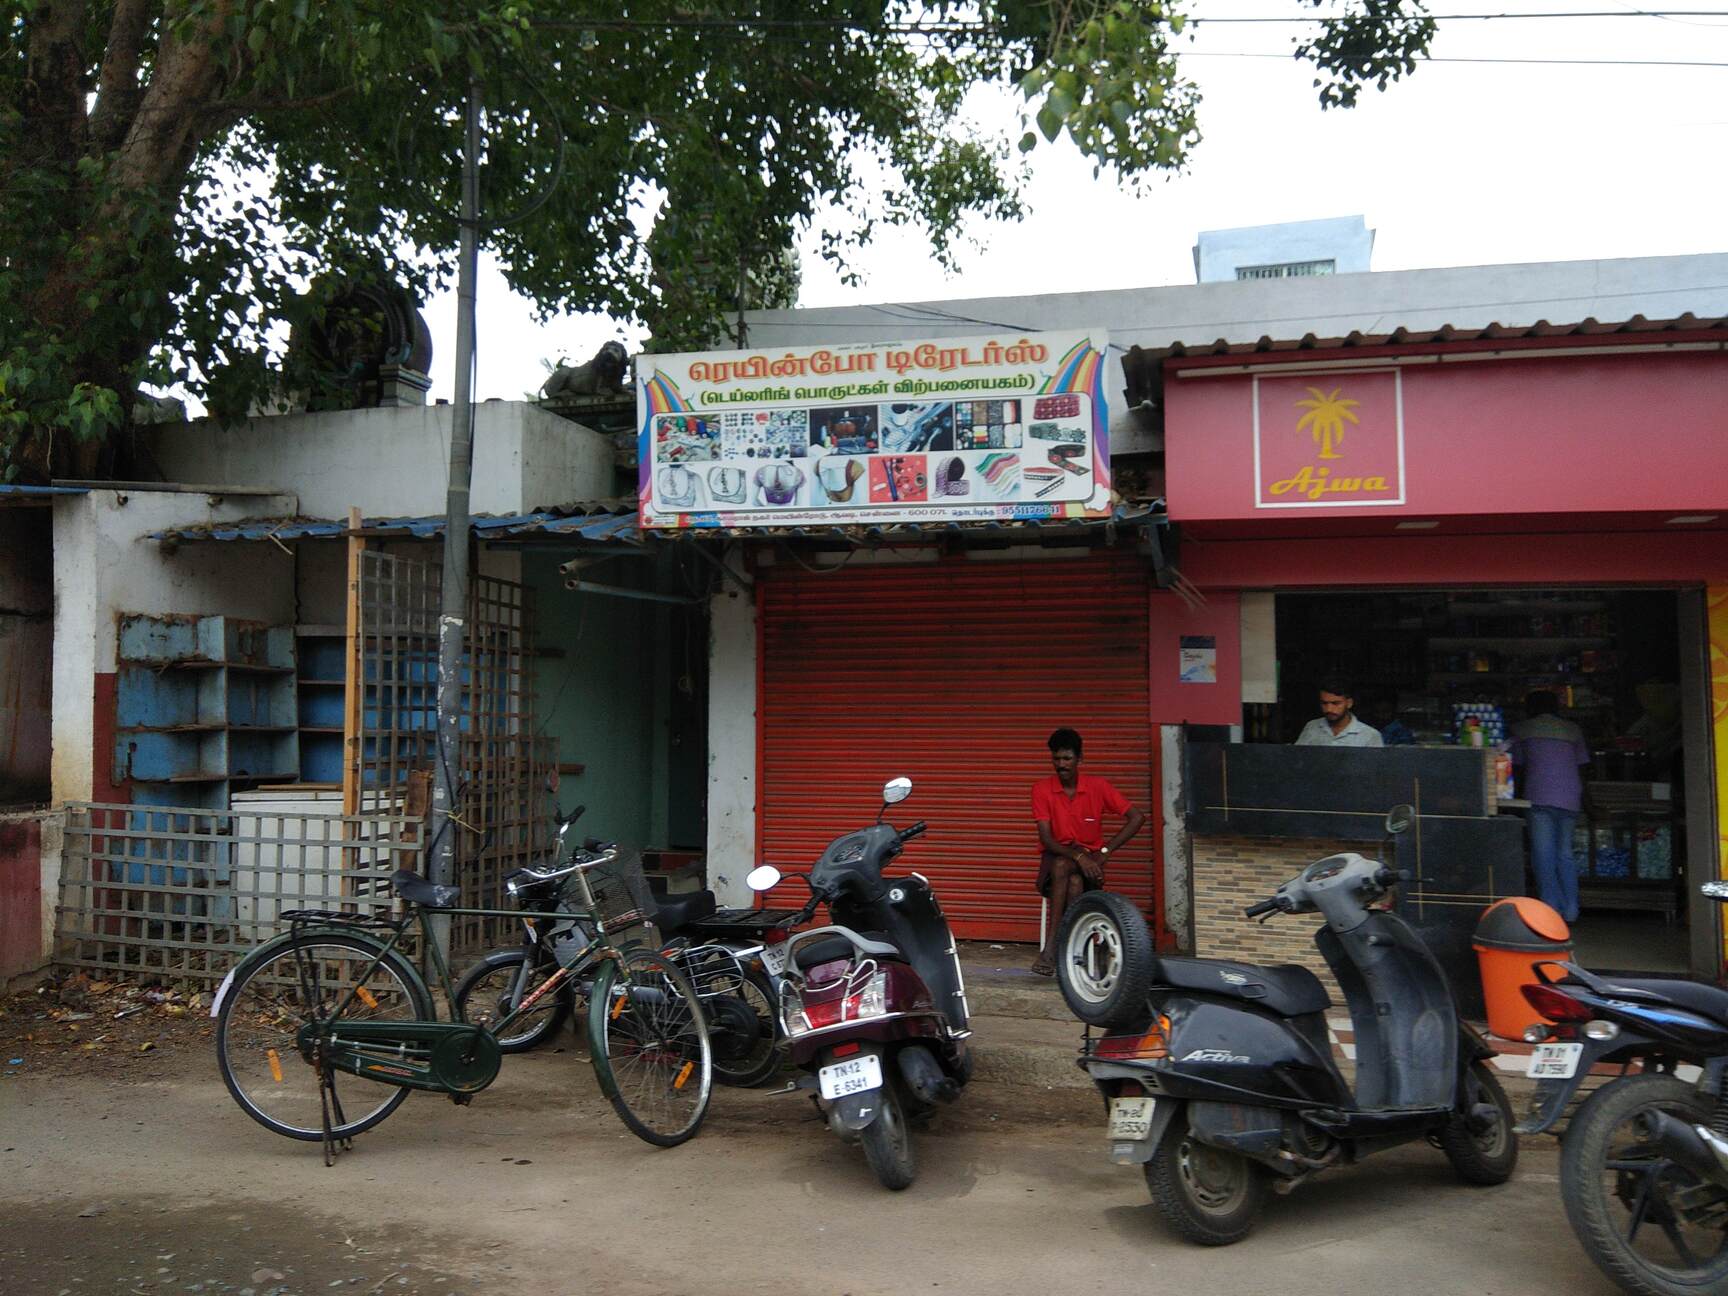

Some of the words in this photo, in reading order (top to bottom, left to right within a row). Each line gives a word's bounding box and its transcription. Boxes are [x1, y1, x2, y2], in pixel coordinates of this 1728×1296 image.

[688, 350, 877, 384] ரெயின்போ
[885, 338, 1048, 375] டிரேடர்ஸ்
[794, 379, 890, 400] பொருட்கள்
[1269, 465, 1391, 499] Ajwa
[908, 508, 928, 516] 600
